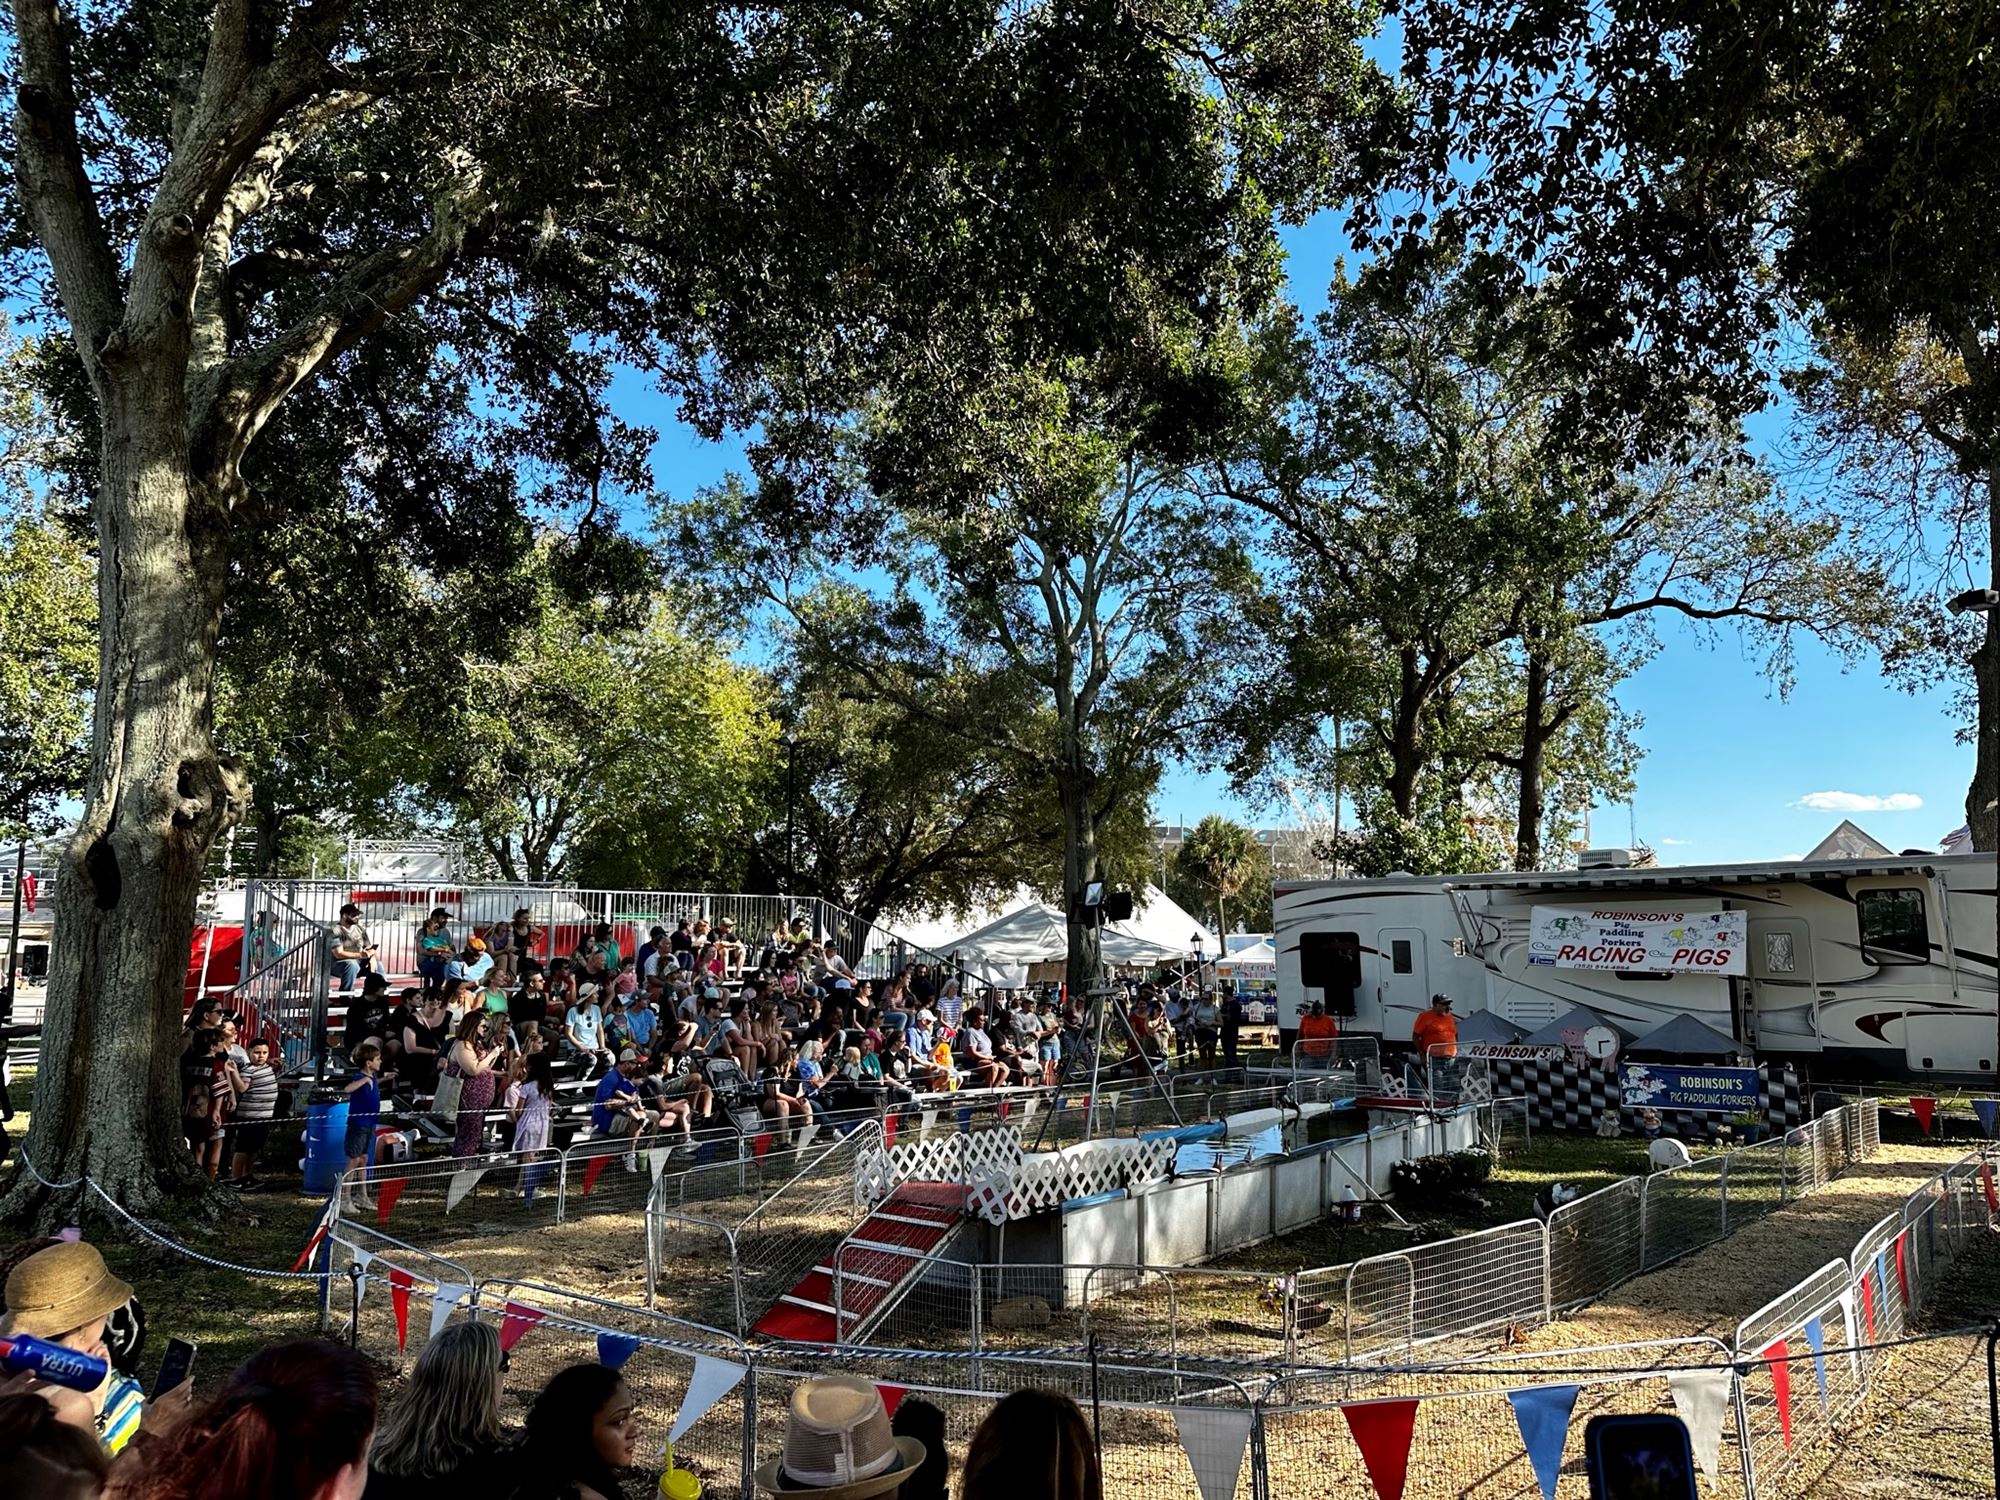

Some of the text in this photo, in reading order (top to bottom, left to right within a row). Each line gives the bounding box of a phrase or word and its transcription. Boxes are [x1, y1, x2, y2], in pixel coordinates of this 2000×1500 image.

[1591, 911, 1685, 922] ROBINSON'S
[1614, 921, 1631, 929] Pig
[1599, 929, 1645, 938] Paddling
[1601, 938, 1642, 947] Porkers
[1557, 945, 1731, 966] RACING PIGS
[1468, 1045, 1551, 1061] ROBINSON'S
[1680, 1076, 1743, 1091] ROBINSON'S
[1670, 1091, 1757, 1106] PIG PADDLING PORKERS
[41, 1352, 84, 1377] ULTRA
